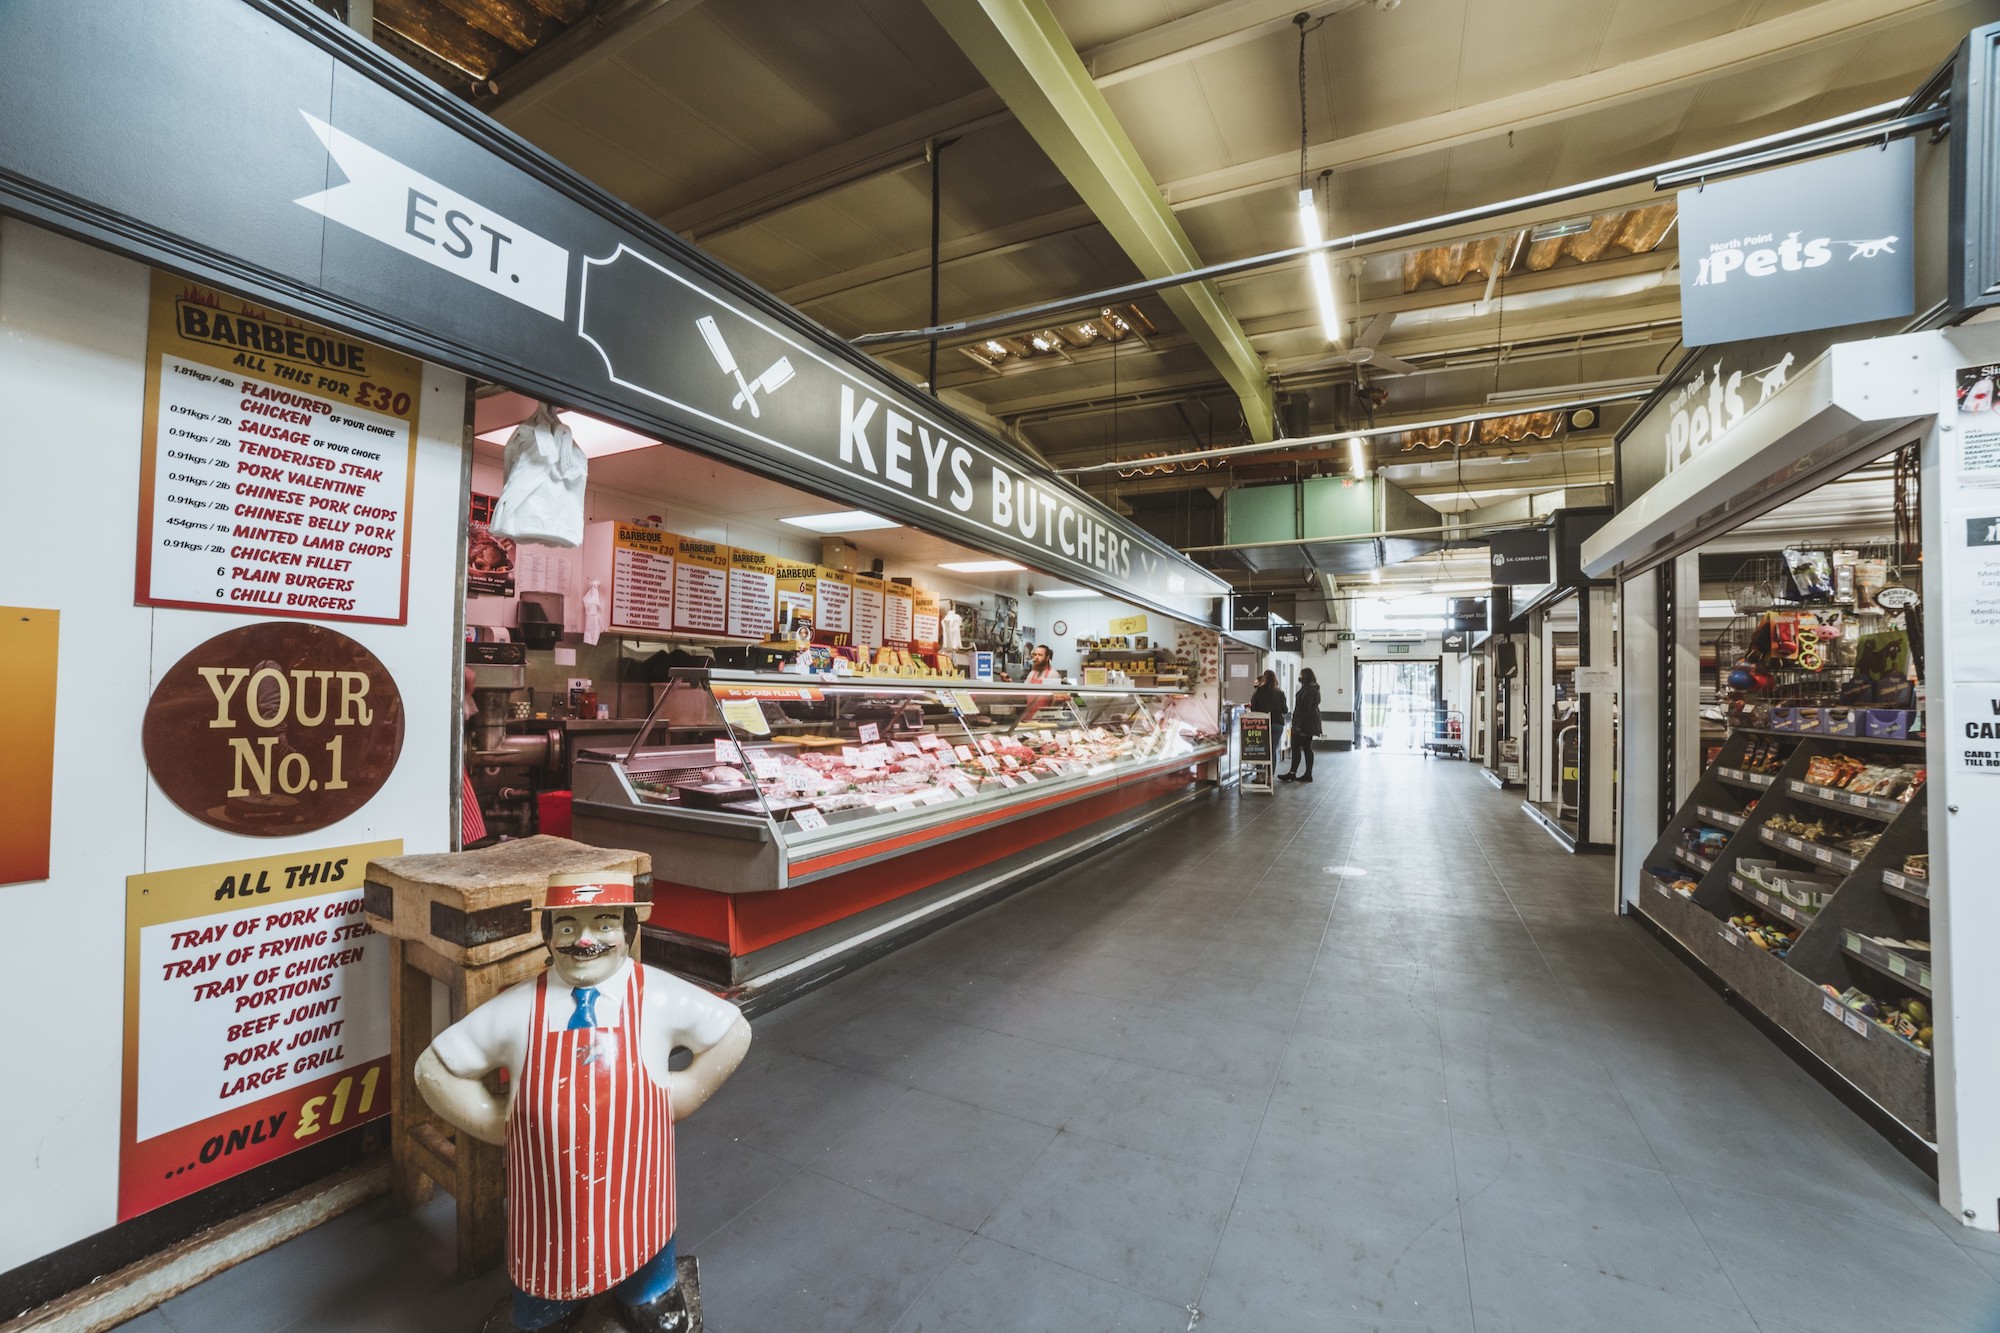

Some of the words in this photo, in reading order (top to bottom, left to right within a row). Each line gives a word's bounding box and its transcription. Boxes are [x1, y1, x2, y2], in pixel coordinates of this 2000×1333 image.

[405, 186, 520, 284] EST.
[1710, 238, 1741, 253] North
[1743, 232, 1773, 247] Point
[1707, 236, 1832, 284] Pets
[181, 304, 366, 372] BARBEQUE
[232, 353, 265, 374] ALL
[273, 363, 310, 385] THIS
[317, 376, 350, 397] FOR
[354, 381, 411, 416] £30
[1981, 365, 2000, 377] Sli
[173, 364, 212, 383] 1.81kgs
[241, 381, 333, 416] FLAVOURED
[330, 414, 342, 424] OF
[343, 417, 365, 431] YOUR
[367, 423, 396, 438] CHOICE
[240, 398, 313, 426] CHICKEN
[169, 428, 208, 442] 0.91kgs
[239, 440, 335, 471] TENDERISED
[339, 462, 383, 482] STEAK
[170, 405, 209, 421] 0.91kgs
[238, 419, 311, 446] SAUSAGE
[313, 439, 326, 448] OF
[327, 441, 350, 454] YOUR
[351, 447, 381, 461] CHOICE
[168, 450, 207, 465] 0.91kgs
[237, 461, 284, 482] PORK
[288, 471, 366, 497] VALENTINE
[840, 383, 974, 513] KEYS
[992, 465, 1130, 580] BUTCHERS
[167, 494, 207, 510] 0.91kgs
[234, 504, 304, 526] CHINESE
[308, 516, 350, 533] BELLY
[354, 524, 396, 541] PORK
[168, 472, 208, 488] 0.91kgs
[235, 482, 305, 506] CHINESE
[309, 496, 351, 515] PORK
[353, 505, 397, 522] CHOPS
[163, 538, 204, 553] 0.91kgs
[231, 546, 302, 567] CHICKEN
[305, 555, 352, 572] FILLET
[166, 516, 208, 531] 454gms
[232, 524, 299, 546] MINTED
[302, 535, 344, 551] LAMB
[348, 542, 392, 558] CHOPS
[619, 530, 662, 543] BARBEQUE
[659, 545, 674, 556] £30
[680, 542, 716, 554] BARBEQUE
[733, 553, 766, 564] BARBEQUE
[217, 567, 225, 577] 6
[231, 566, 281, 584] PLAIN
[285, 574, 354, 592] BURGERS
[713, 555, 727, 566] £20
[763, 565, 775, 575] £15
[776, 568, 816, 580] BARBEQUE
[834, 573, 844, 581] THIS
[216, 588, 224, 598] 6
[230, 587, 283, 605] CHILLI
[286, 594, 356, 612] BURGERS
[799, 581, 806, 593] 6
[834, 633, 848, 646] £11
[198, 666, 373, 729] YOUR
[743, 689, 771, 697] CHICKEN
[227, 734, 348, 798] No.1
[214, 871, 271, 902] ALL
[284, 859, 350, 890] THIS
[170, 923, 229, 951] TRAY
[232, 917, 261, 939] OF
[266, 906, 320, 933] PORK
[323, 896, 365, 918] CHO
[162, 953, 222, 982] TRAY
[225, 945, 255, 967] OF
[258, 931, 327, 961] FRYING
[331, 922, 376, 943] STEA
[193, 974, 248, 1002] TRAY
[253, 968, 281, 988] OF
[284, 947, 364, 980] CHICKEN
[234, 973, 334, 1013] PORTIONS
[226, 1012, 280, 1042] BEEF
[283, 996, 342, 1026] JOINT
[223, 1040, 283, 1071] PORK
[286, 1020, 344, 1051] JOINT
[219, 1063, 289, 1100] LARGE
[293, 1045, 345, 1074] GRILL
[294, 1066, 381, 1140] £11
